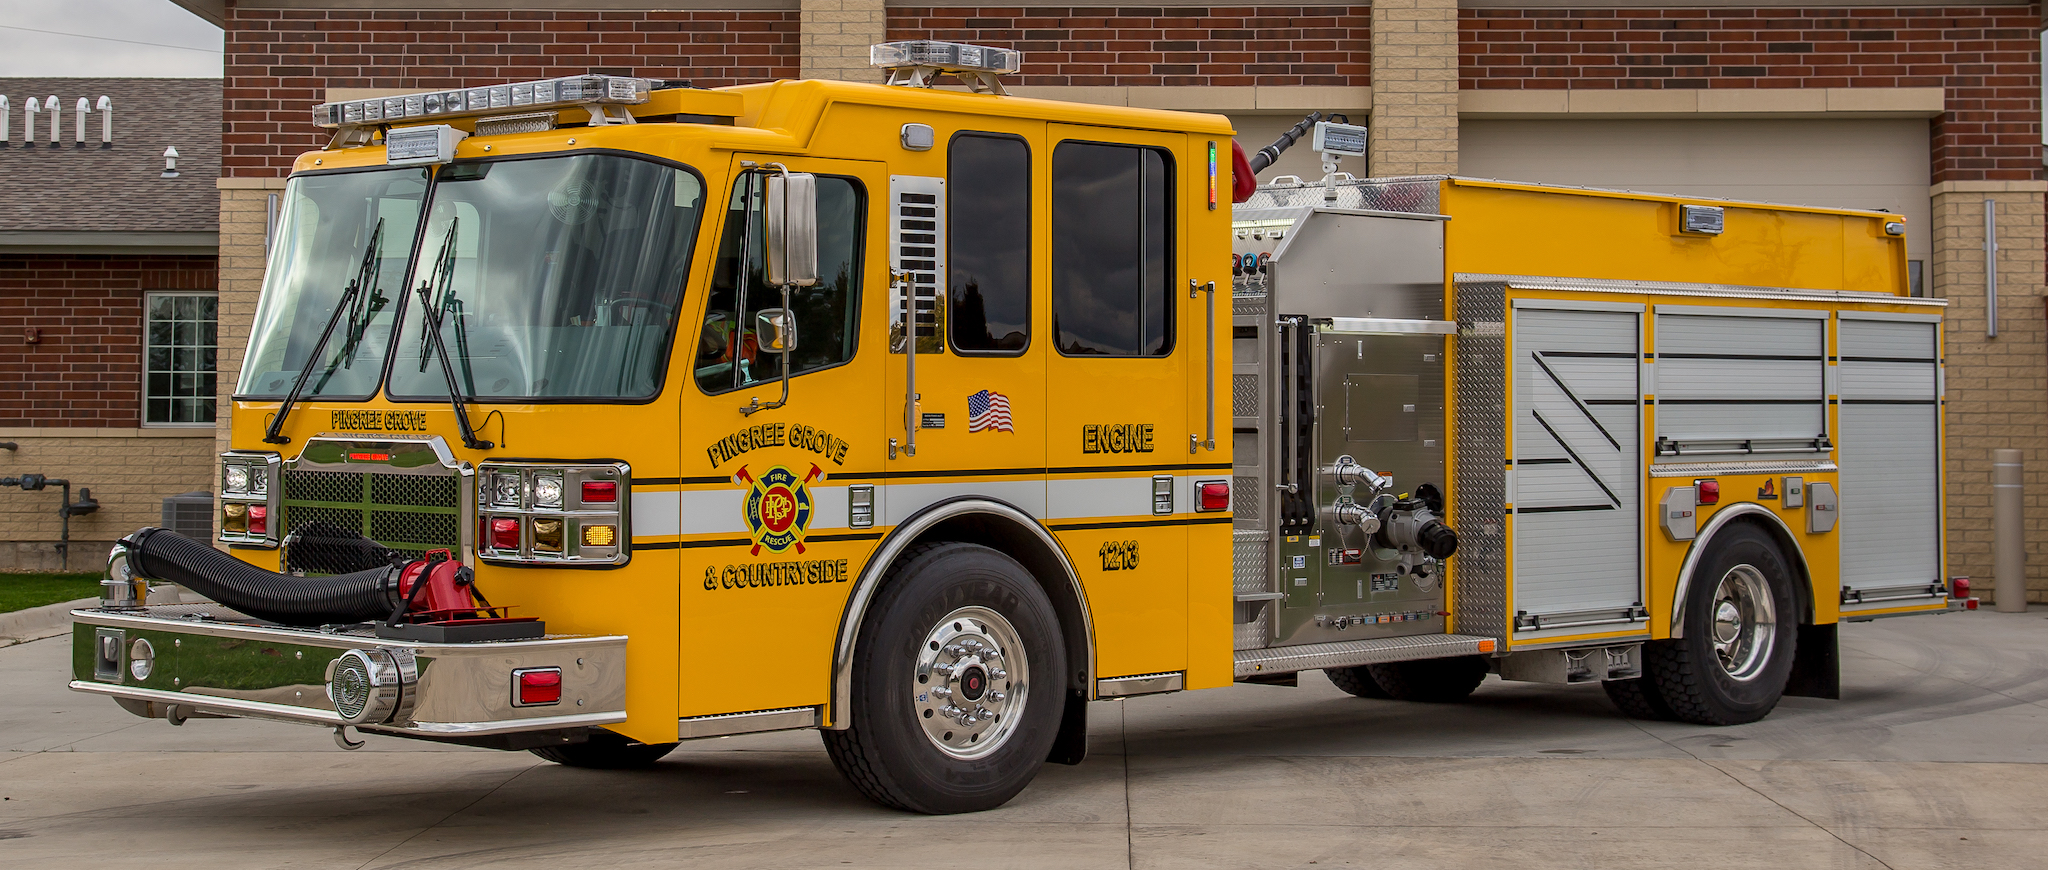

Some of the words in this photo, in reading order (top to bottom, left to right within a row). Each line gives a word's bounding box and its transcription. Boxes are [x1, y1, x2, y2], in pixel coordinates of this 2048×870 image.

[331, 409, 382, 430] PINGREE
[385, 410, 427, 431] GROVE
[707, 423, 785, 469] PINGREE
[789, 423, 849, 466] GROVE
[1083, 424, 1154, 454] ENGINE
[770, 473, 787, 482] FIRE
[765, 533, 793, 546] RESCUE
[1099, 540, 1139, 572] 1213
[704, 565, 718, 591] &
[721, 558, 848, 590] COUNTRYSIDE
